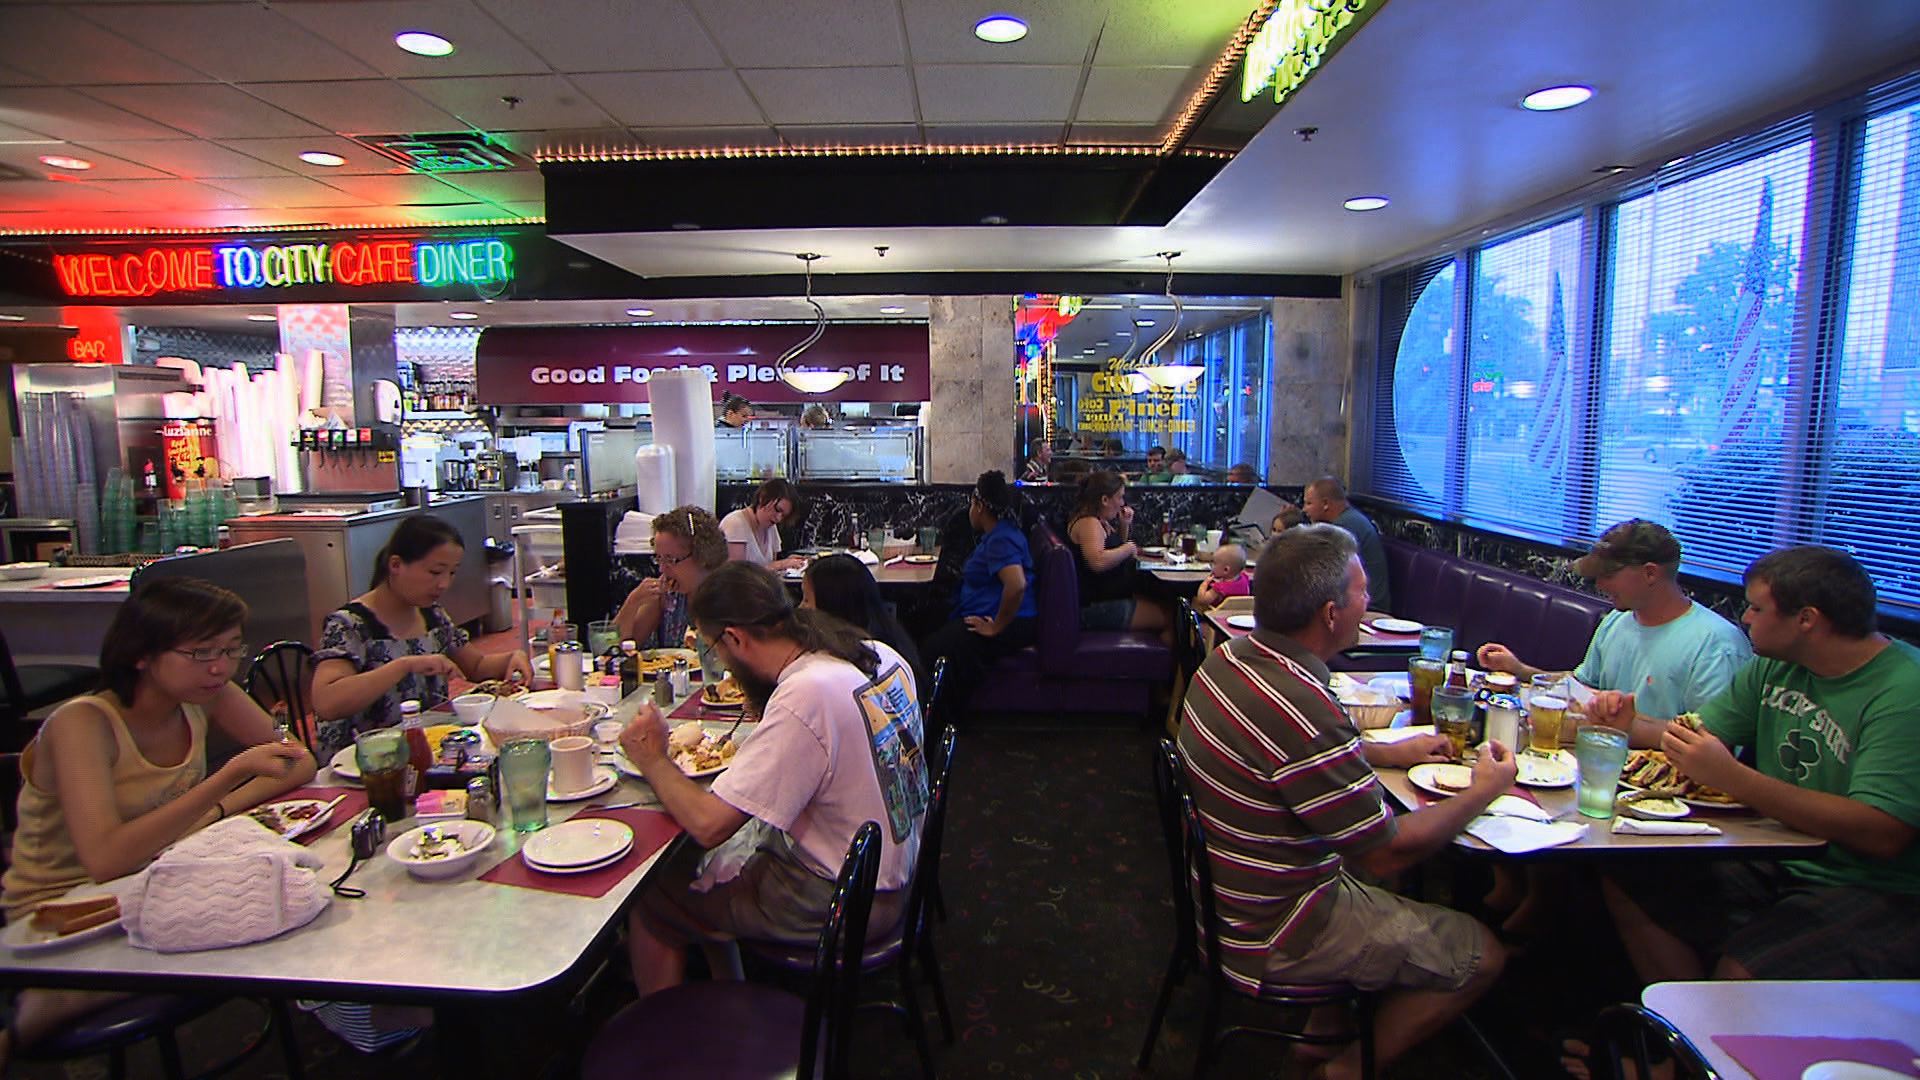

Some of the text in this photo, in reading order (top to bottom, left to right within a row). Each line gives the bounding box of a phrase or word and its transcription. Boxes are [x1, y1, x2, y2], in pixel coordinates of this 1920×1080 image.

[57, 239, 508, 296] WELCOME TO CITY CAFE DINER
[73, 339, 106, 358] BAR
[531, 366, 606, 384] Good
[613, 366, 688, 383] Fo
[728, 364, 829, 383] Ple
[880, 364, 905, 382] It
